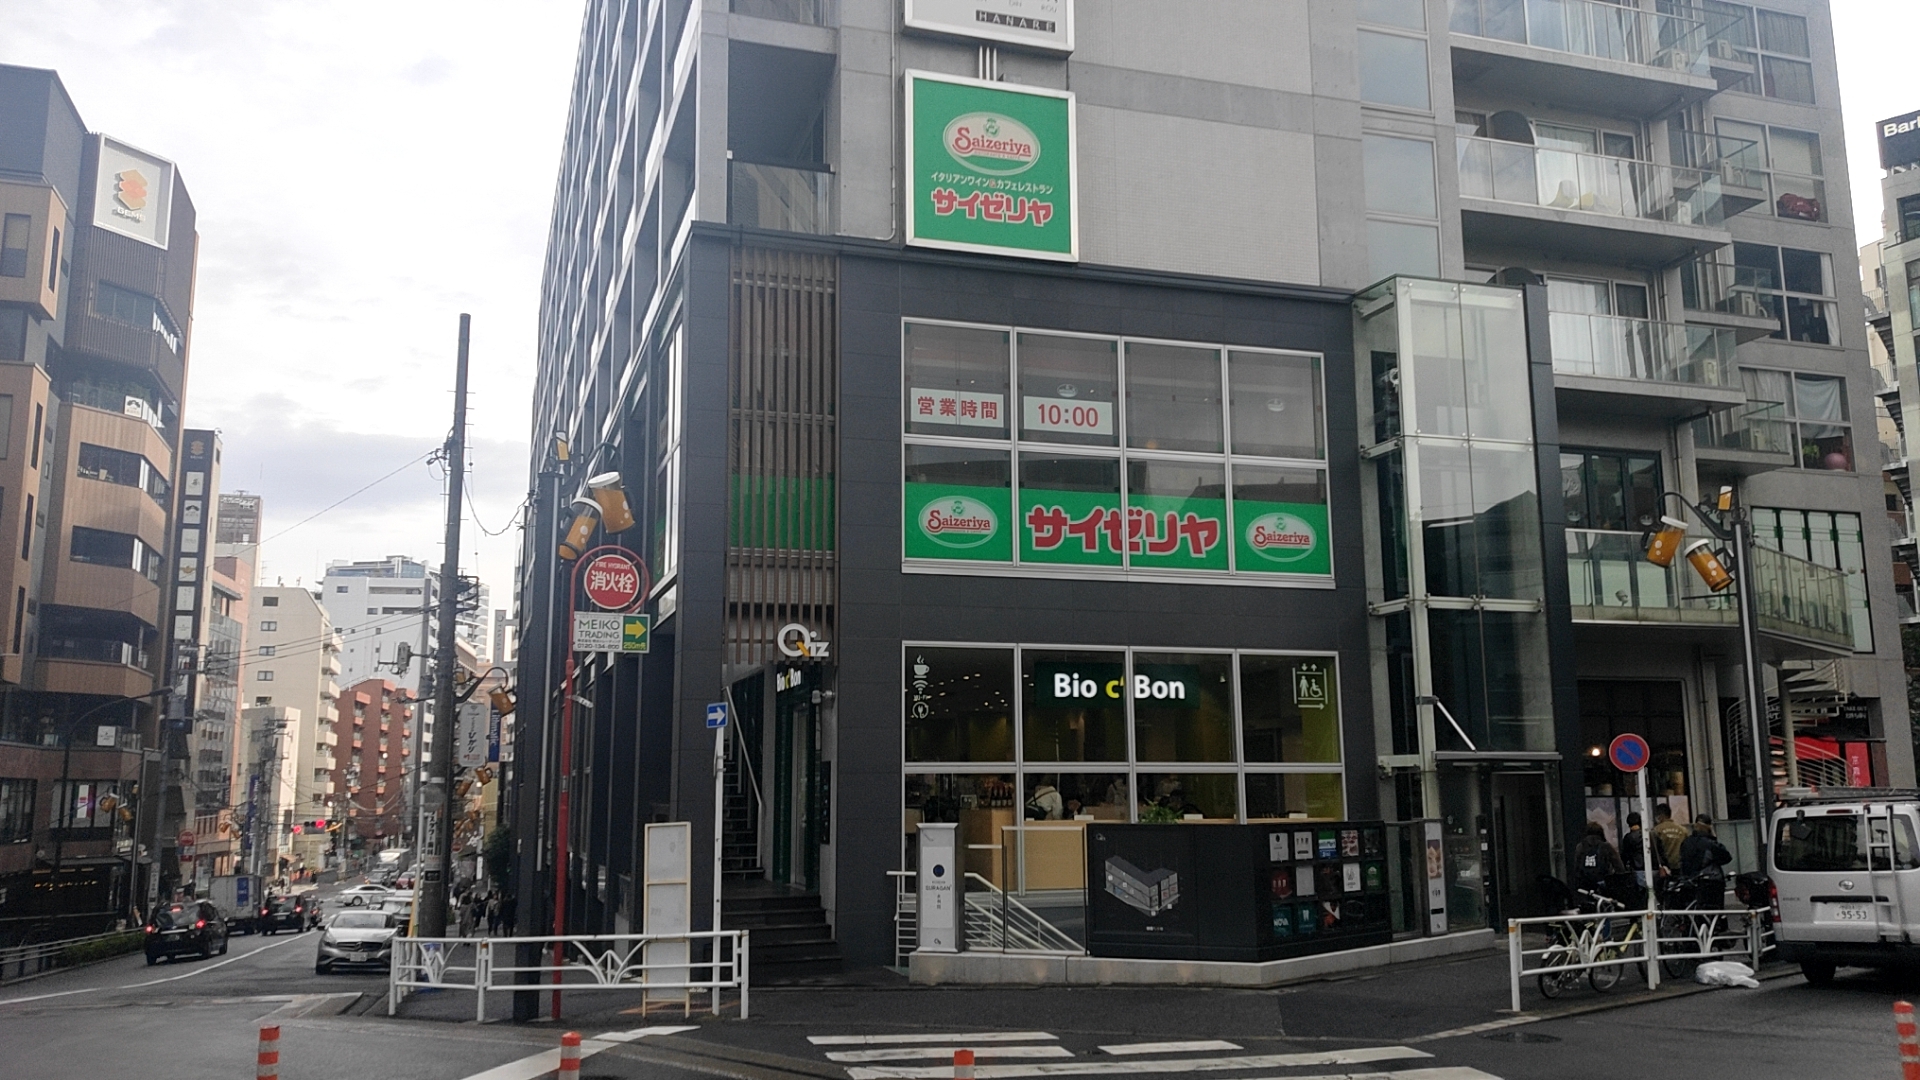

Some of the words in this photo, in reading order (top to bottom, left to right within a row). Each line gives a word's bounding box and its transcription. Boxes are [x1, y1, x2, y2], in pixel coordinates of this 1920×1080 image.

[978, 11, 1055, 33] HANARE
[952, 126, 1032, 156] Saizeriya
[931, 187, 1053, 227] サイゼリヤ
[917, 396, 998, 420] 営業時間
[1038, 403, 1099, 428] 10:00
[925, 509, 991, 534] Saizeriya
[1026, 504, 1220, 558] サイゼリヤ
[1252, 525, 1312, 548] Saizeriya
[595, 561, 607, 569] FIRE
[589, 569, 635, 594] 消火栓
[578, 619, 620, 630] MEIKO
[578, 630, 620, 640] TRADING
[1054, 672, 1098, 698] Bio
[1134, 674, 1186, 700] Bon
